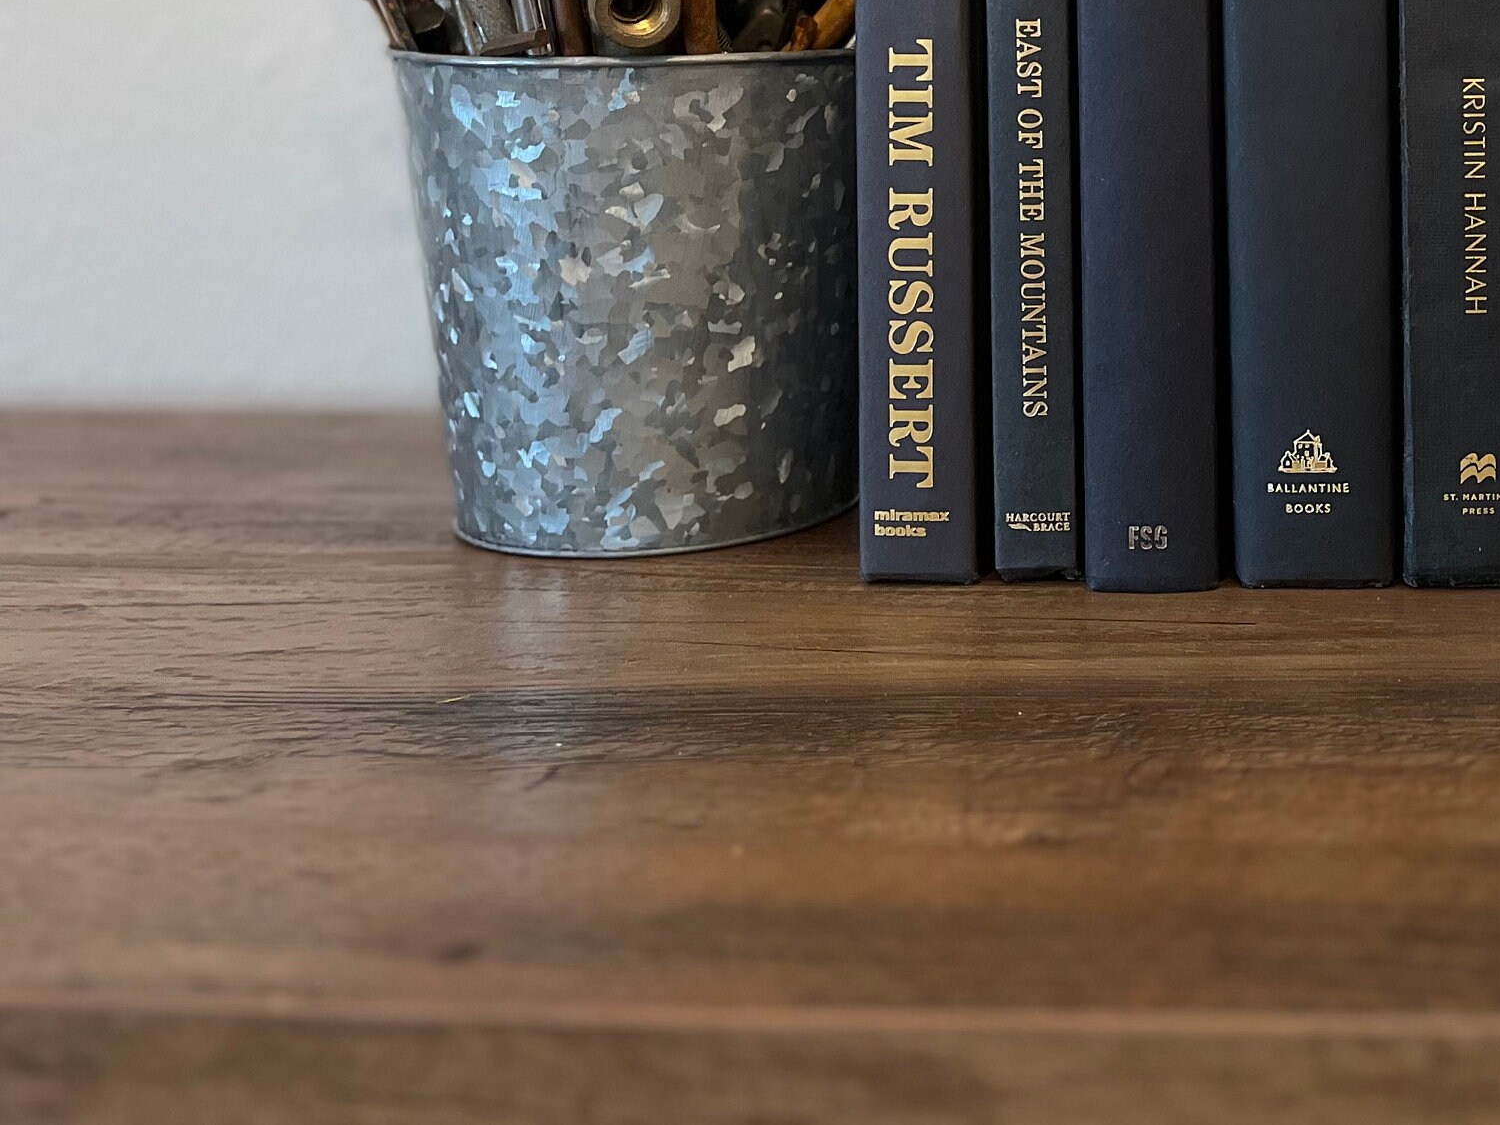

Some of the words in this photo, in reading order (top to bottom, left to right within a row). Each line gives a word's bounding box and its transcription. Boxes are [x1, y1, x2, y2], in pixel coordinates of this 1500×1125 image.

[1016, 19, 1042, 97] EAST
[889, 39, 933, 166] TIM
[1018, 109, 1043, 148] OF
[1463, 79, 1485, 178] KRISTIN
[1019, 159, 1044, 221] THE
[1464, 194, 1487, 313] HANNAH
[1020, 233, 1048, 417] MOUNTAINS
[888, 188, 933, 487] RUSSERT
[1267, 482, 1350, 494] BALLANTINE
[1443, 493, 1457, 501] ST.
[874, 508, 950, 522] miramax
[1005, 511, 1071, 525] HARCOURT
[1285, 503, 1331, 514] BOOKS
[1462, 507, 1495, 515] PRESS
[874, 523, 927, 537] books
[1032, 521, 1071, 532] BRACE
[1129, 526, 1167, 549] FSG
